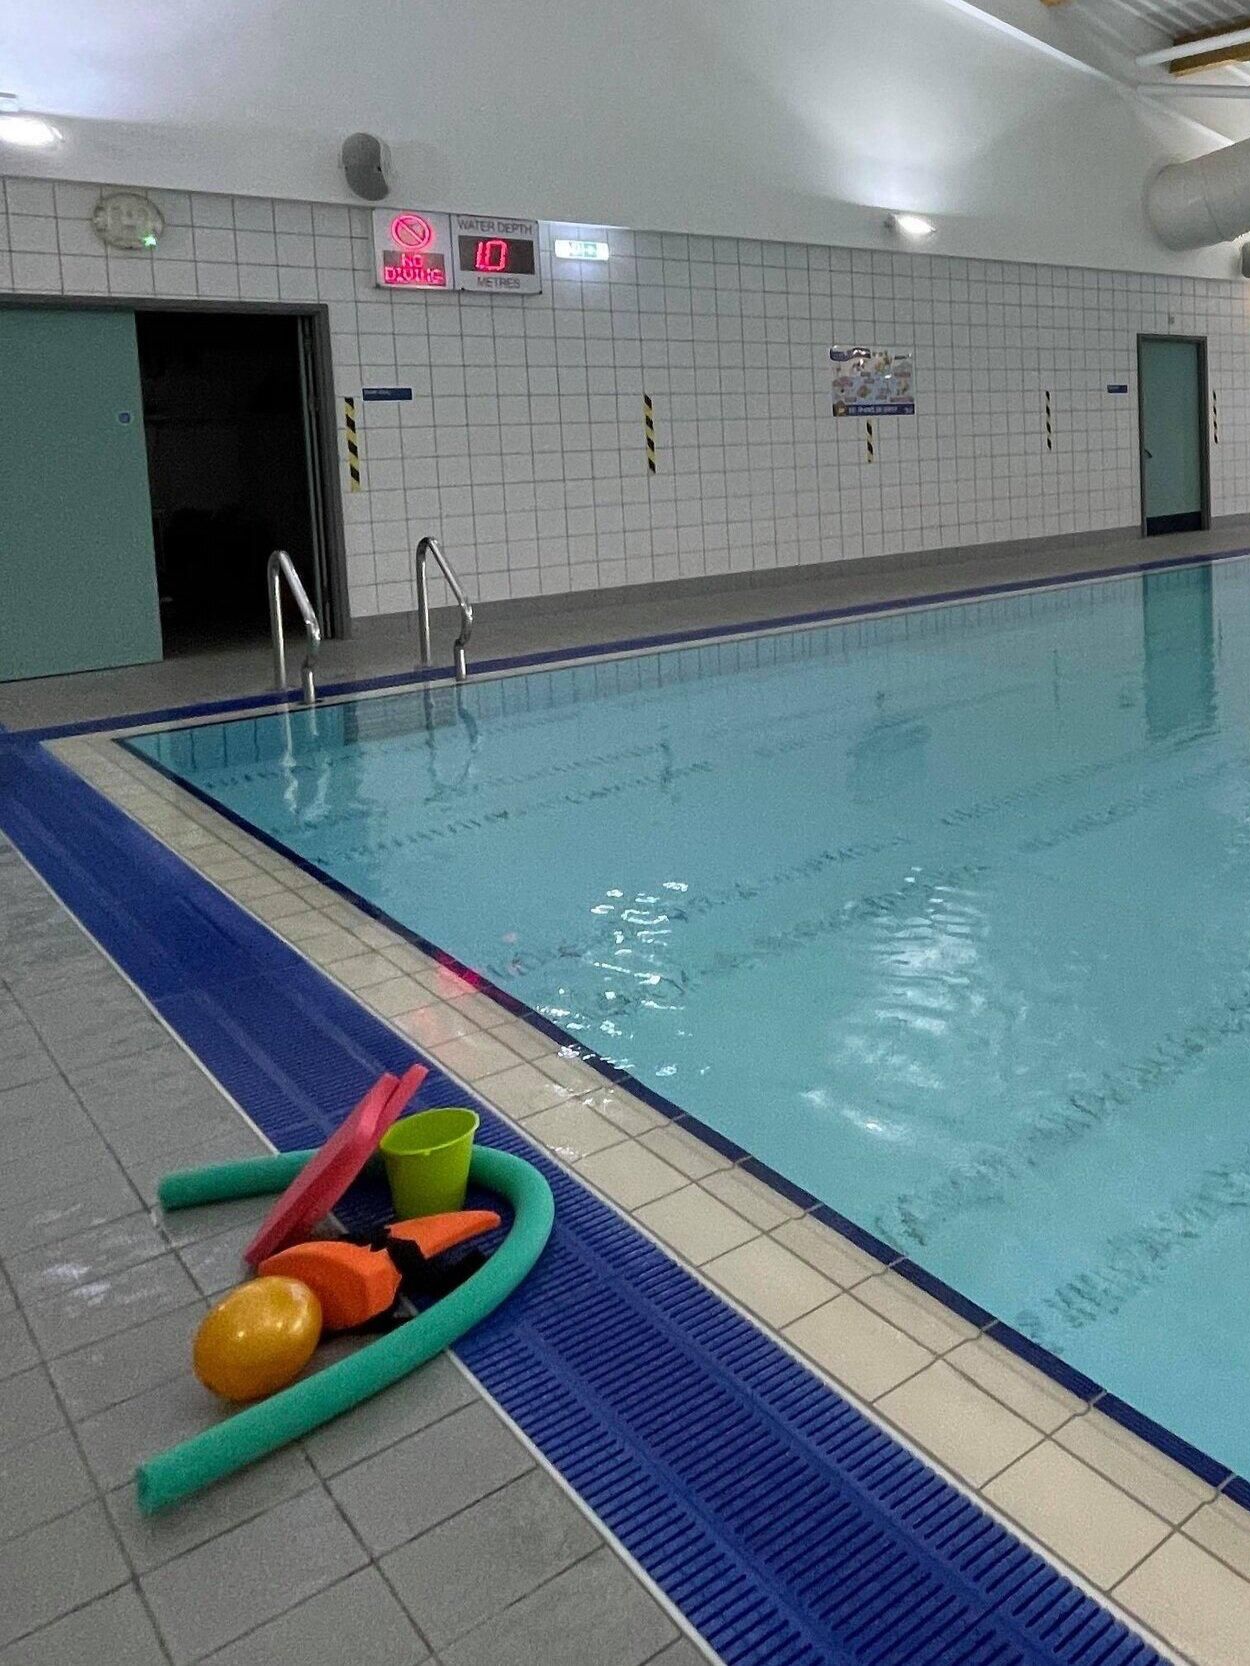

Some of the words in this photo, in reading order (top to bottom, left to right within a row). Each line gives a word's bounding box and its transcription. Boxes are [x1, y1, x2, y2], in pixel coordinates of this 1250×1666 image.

[458, 219, 495, 233] WATER
[497, 222, 533, 235] DEPTH
[401, 253, 424, 268] NO
[477, 276, 521, 288] METRES
